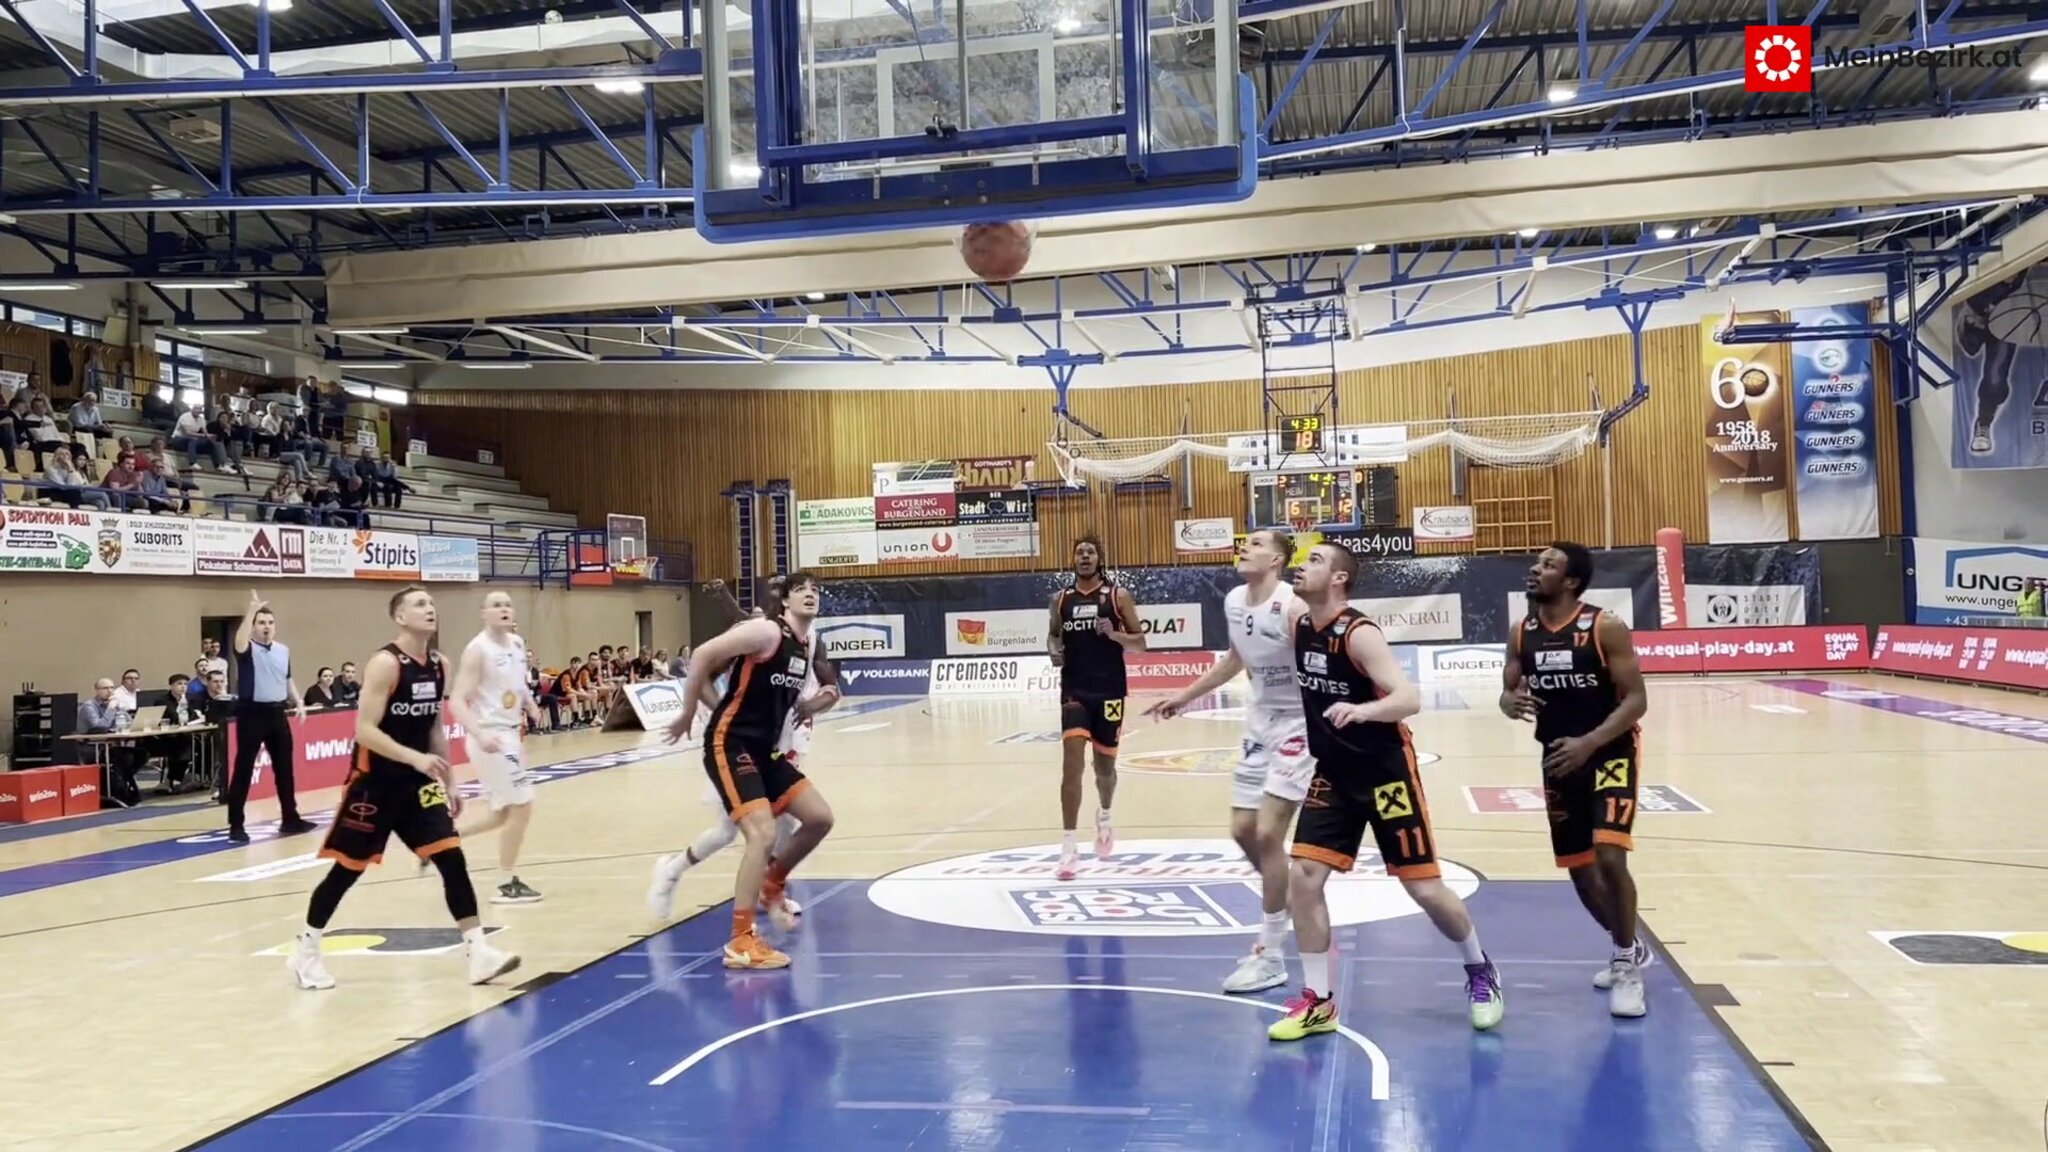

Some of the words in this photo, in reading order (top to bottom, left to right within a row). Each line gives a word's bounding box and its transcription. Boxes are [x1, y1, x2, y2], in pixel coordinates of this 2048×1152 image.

[1804, 383, 1854, 396] GUNNERS
[1806, 409, 1856, 422] GUNNERS
[1291, 418, 1318, 430] 4:33
[1716, 421, 1755, 436] 1958
[1296, 431, 1313, 448] 18
[1731, 430, 1771, 445] 2018
[1806, 434, 1856, 447] GUNNERS
[1713, 442, 1778, 453] Anniversary
[1807, 462, 1858, 475] GUNNERS
[1720, 476, 1774, 484] www.gunners.at
[891, 498, 938, 509] CATERING
[959, 501, 985, 515] Stadt
[8, 509, 64, 525] SPEDITION
[68, 513, 91, 526] PALL
[817, 506, 875, 518] ADAKOVICS
[883, 508, 947, 519] BURGENLAND
[134, 532, 183, 546] SUBORITS
[309, 530, 324, 544] Die
[327, 532, 339, 545] Nr.
[883, 543, 928, 553] union
[364, 542, 416, 569] Stipits
[1245, 616, 1253, 635] 9
[1377, 610, 1450, 627] GENERALI
[987, 636, 1037, 647] Burgenland
[1328, 637, 1339, 653] 11
[1572, 632, 1589, 647] 17
[1825, 633, 1860, 643] EQUAL
[1826, 651, 1847, 661] DAY
[862, 667, 930, 679] VOLKSBANK
[936, 660, 1018, 682] cremesso
[1540, 673, 1599, 690] CITIES
[1605, 796, 1634, 826] 17
[1395, 826, 1426, 859] 11
